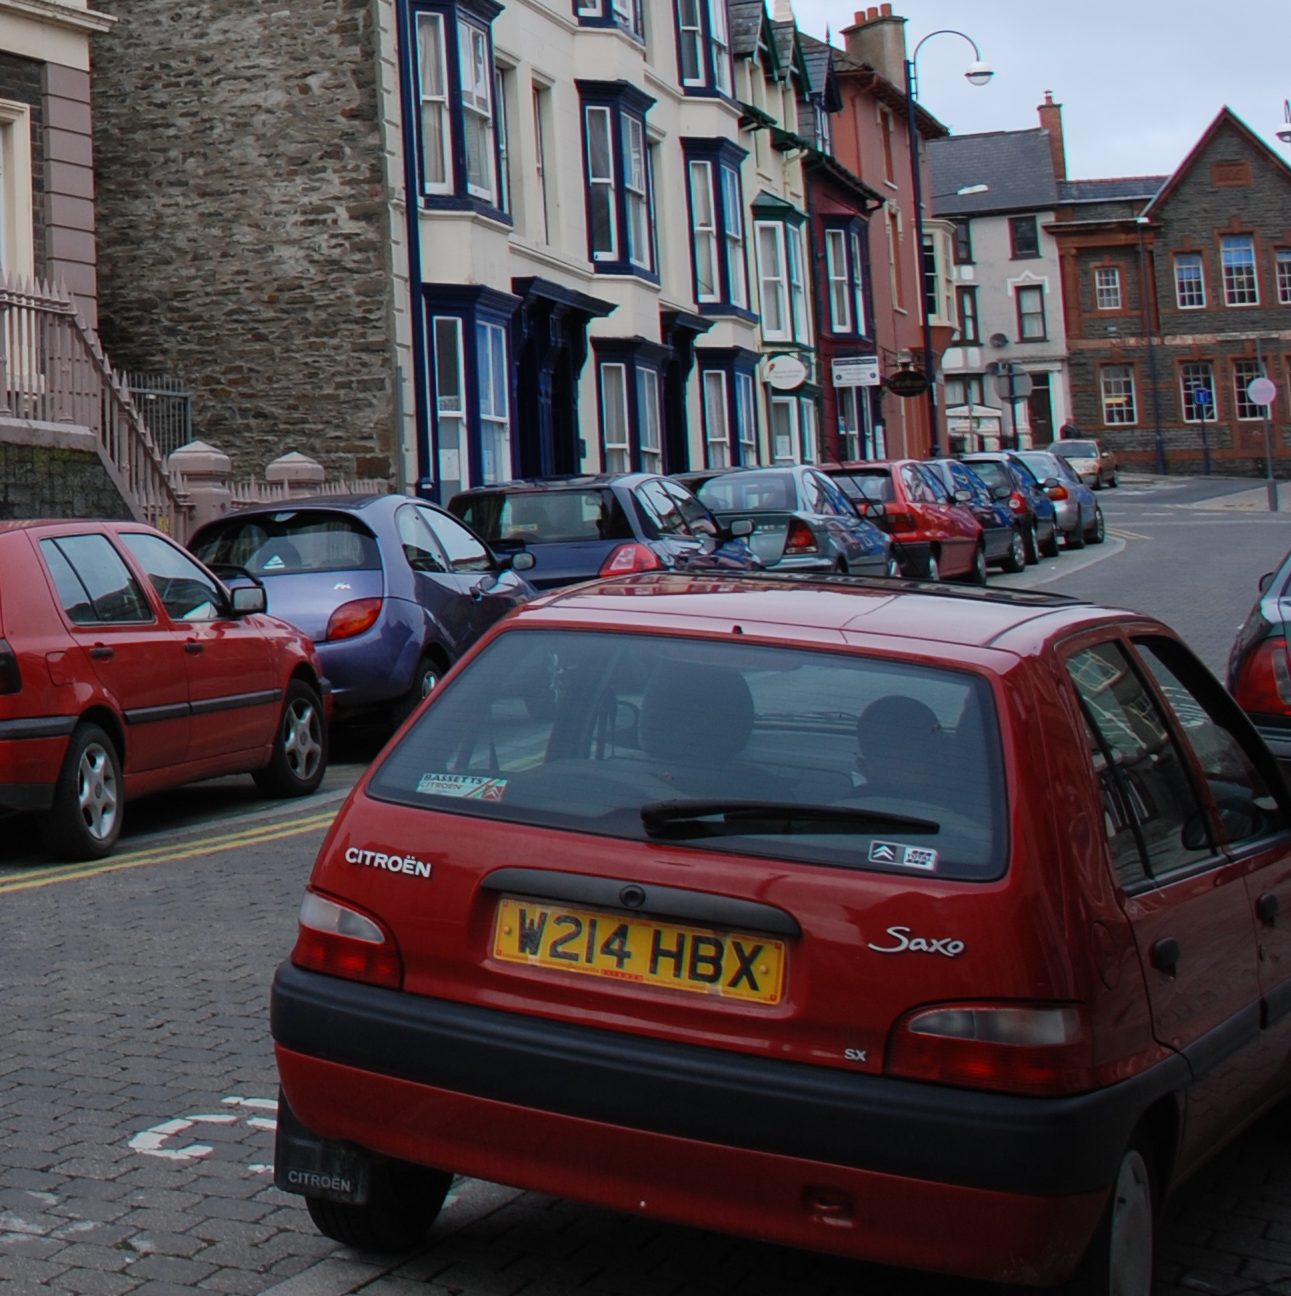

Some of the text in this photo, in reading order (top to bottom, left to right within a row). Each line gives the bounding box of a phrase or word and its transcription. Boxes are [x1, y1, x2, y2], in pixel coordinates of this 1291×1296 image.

[345, 847, 432, 878] CITROËN
[518, 908, 765, 992] W214 HBX
[867, 926, 964, 957] Saxo
[844, 1048, 866, 1062] SX
[287, 1169, 351, 1193] CITROËN
